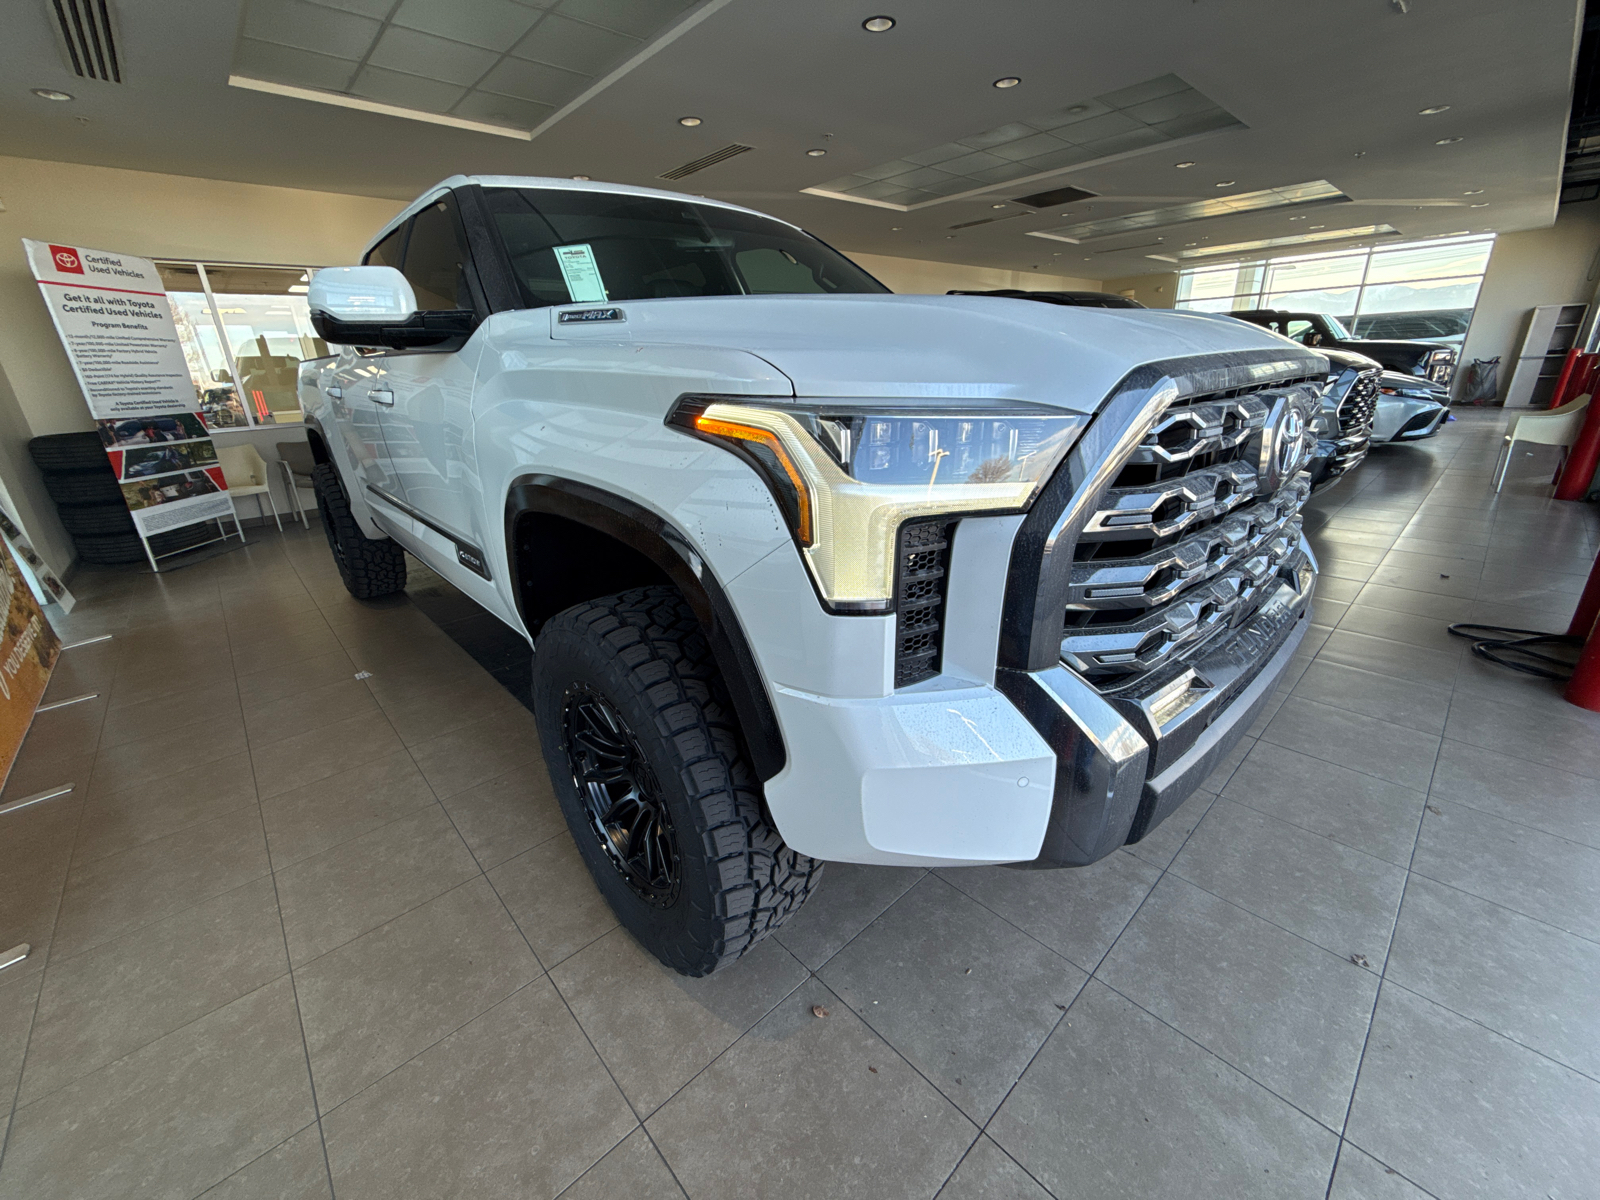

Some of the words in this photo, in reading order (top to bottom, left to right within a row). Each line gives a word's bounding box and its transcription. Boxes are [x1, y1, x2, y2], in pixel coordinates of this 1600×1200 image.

[85, 255, 122, 267] Certified
[88, 265, 110, 275] Used
[111, 268, 145, 279] Vehicles
[64, 294, 82, 303] Get
[83, 295, 92, 303] it
[93, 296, 104, 305] all
[106, 298, 126, 307] with
[127, 300, 155, 310] Toyota
[62, 304, 104, 315] Certified
[106, 308, 128, 317] Used
[129, 309, 162, 319] Vehicles
[582, 310, 614, 319] MAX
[91, 321, 121, 329] Program
[1225, 601, 1293, 663] TUNDRA
[3, 652, 20, 679] YOU
[13, 622, 34, 662] DESERVE
